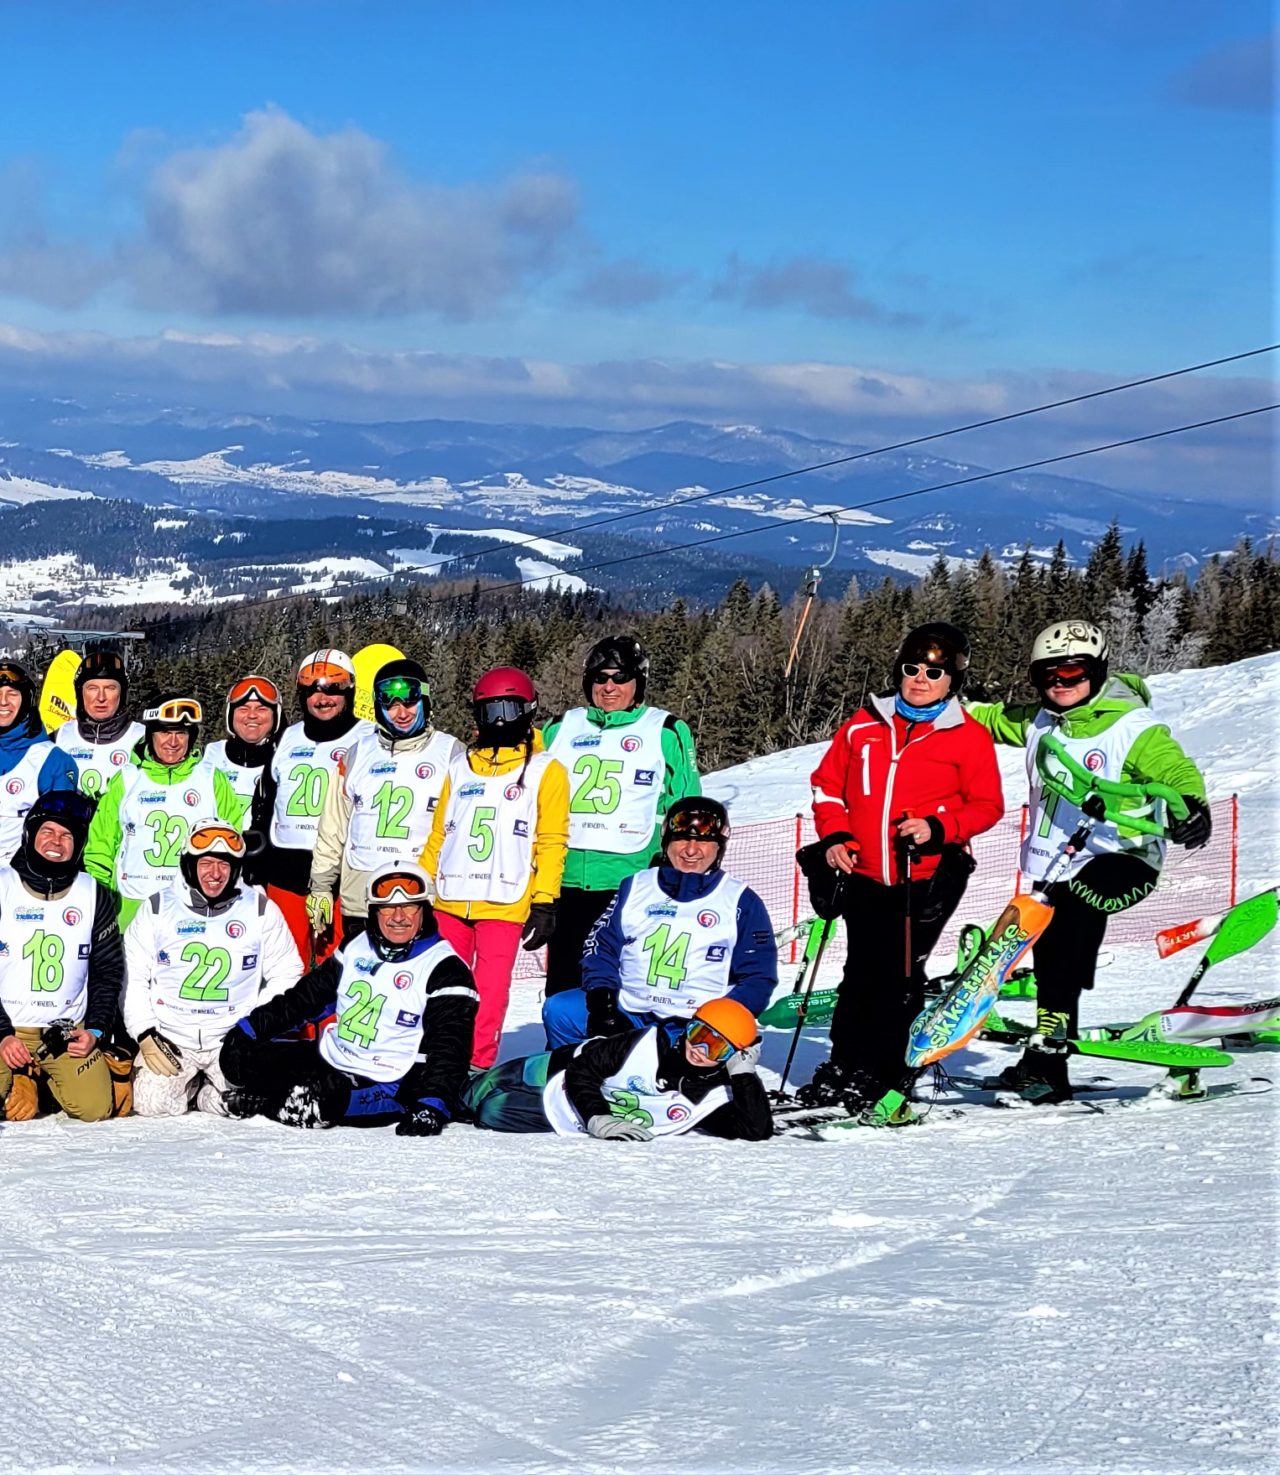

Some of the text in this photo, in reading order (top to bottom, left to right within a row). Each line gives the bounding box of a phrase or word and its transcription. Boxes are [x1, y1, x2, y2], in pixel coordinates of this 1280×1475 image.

[286, 763, 329, 817] 20
[371, 780, 414, 839] 12
[570, 754, 624, 814] 25
[144, 810, 188, 867] 32
[468, 806, 496, 862] 5
[22, 929, 64, 992] 18
[179, 942, 231, 1001] 22
[643, 923, 691, 990] 14
[338, 980, 387, 1049] 24
